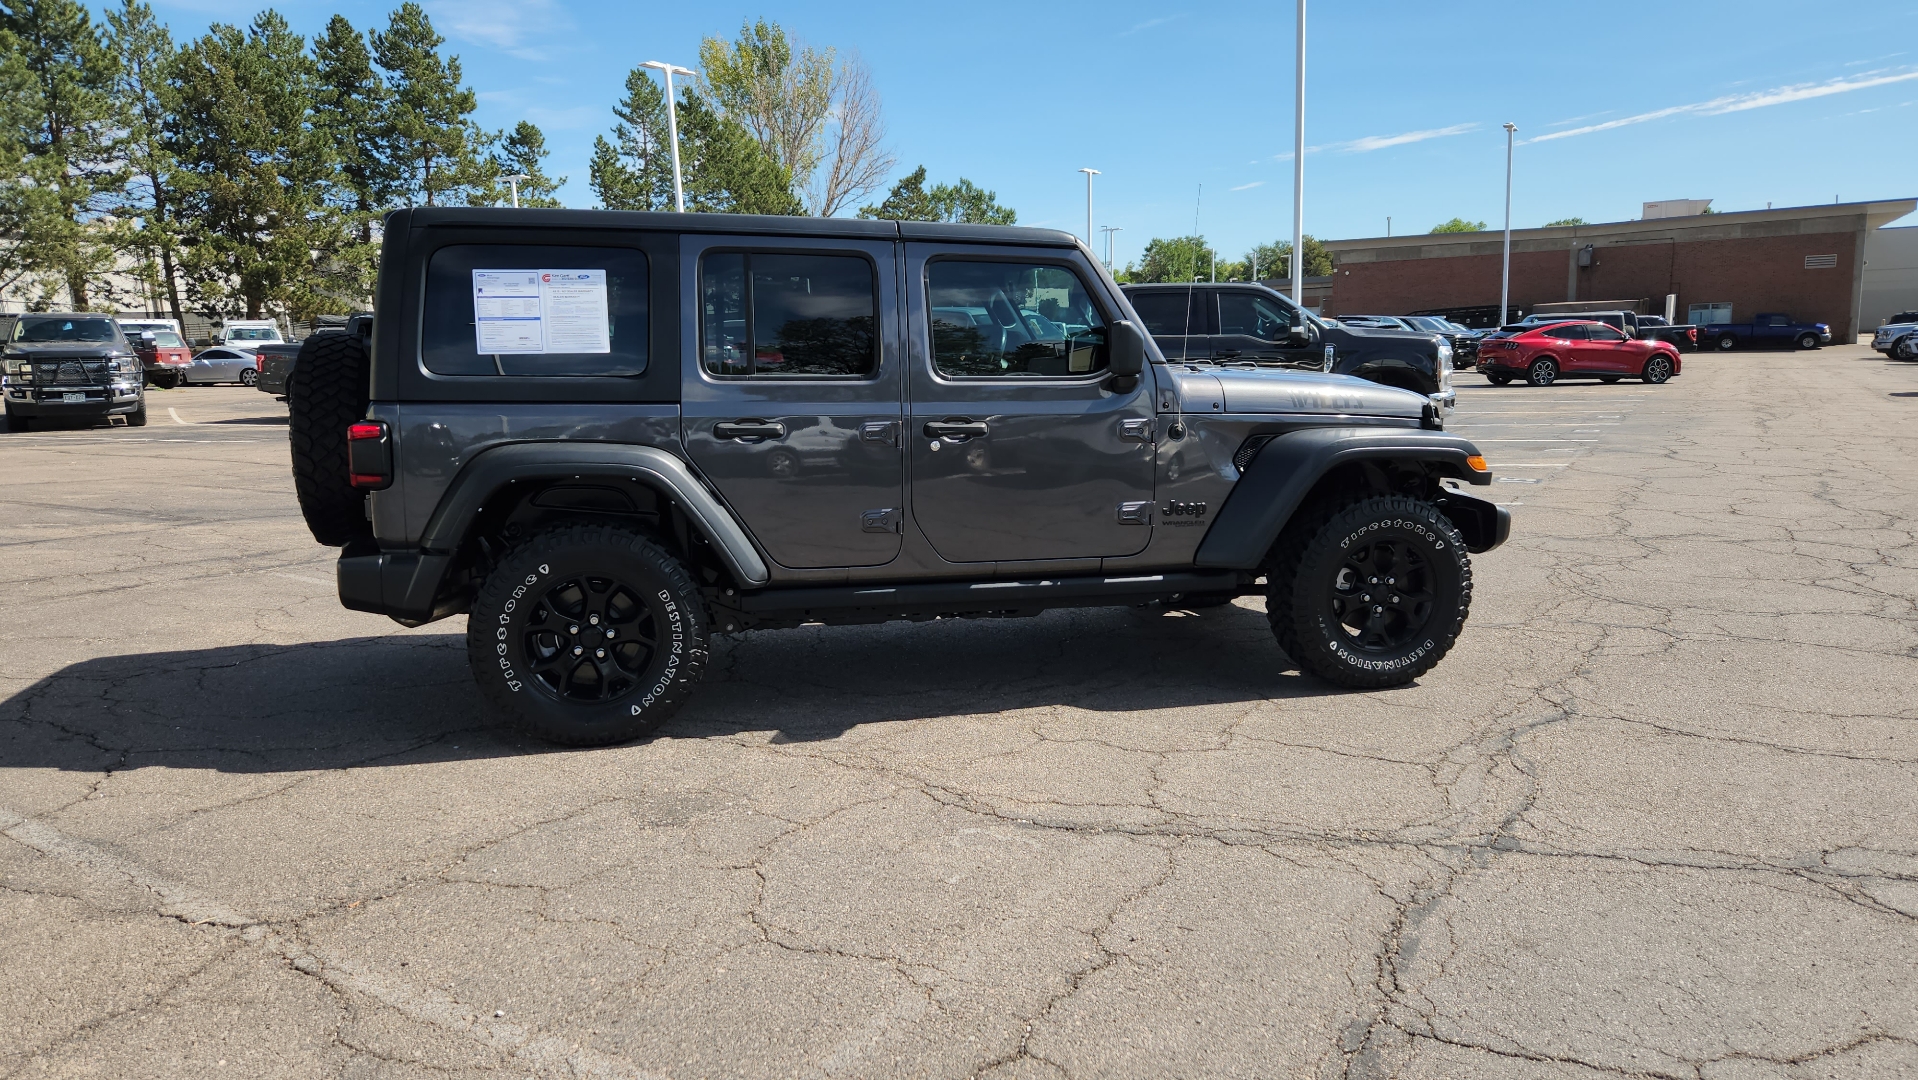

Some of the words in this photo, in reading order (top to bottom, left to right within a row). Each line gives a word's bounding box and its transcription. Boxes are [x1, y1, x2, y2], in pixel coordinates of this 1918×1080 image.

[1162, 499, 1207, 519] Jeep
[1341, 519, 1436, 549] Firestone
[497, 574, 538, 692] Firestone
[642, 589, 683, 708] DESTINATION
[1337, 639, 1435, 670] DESTINATION
